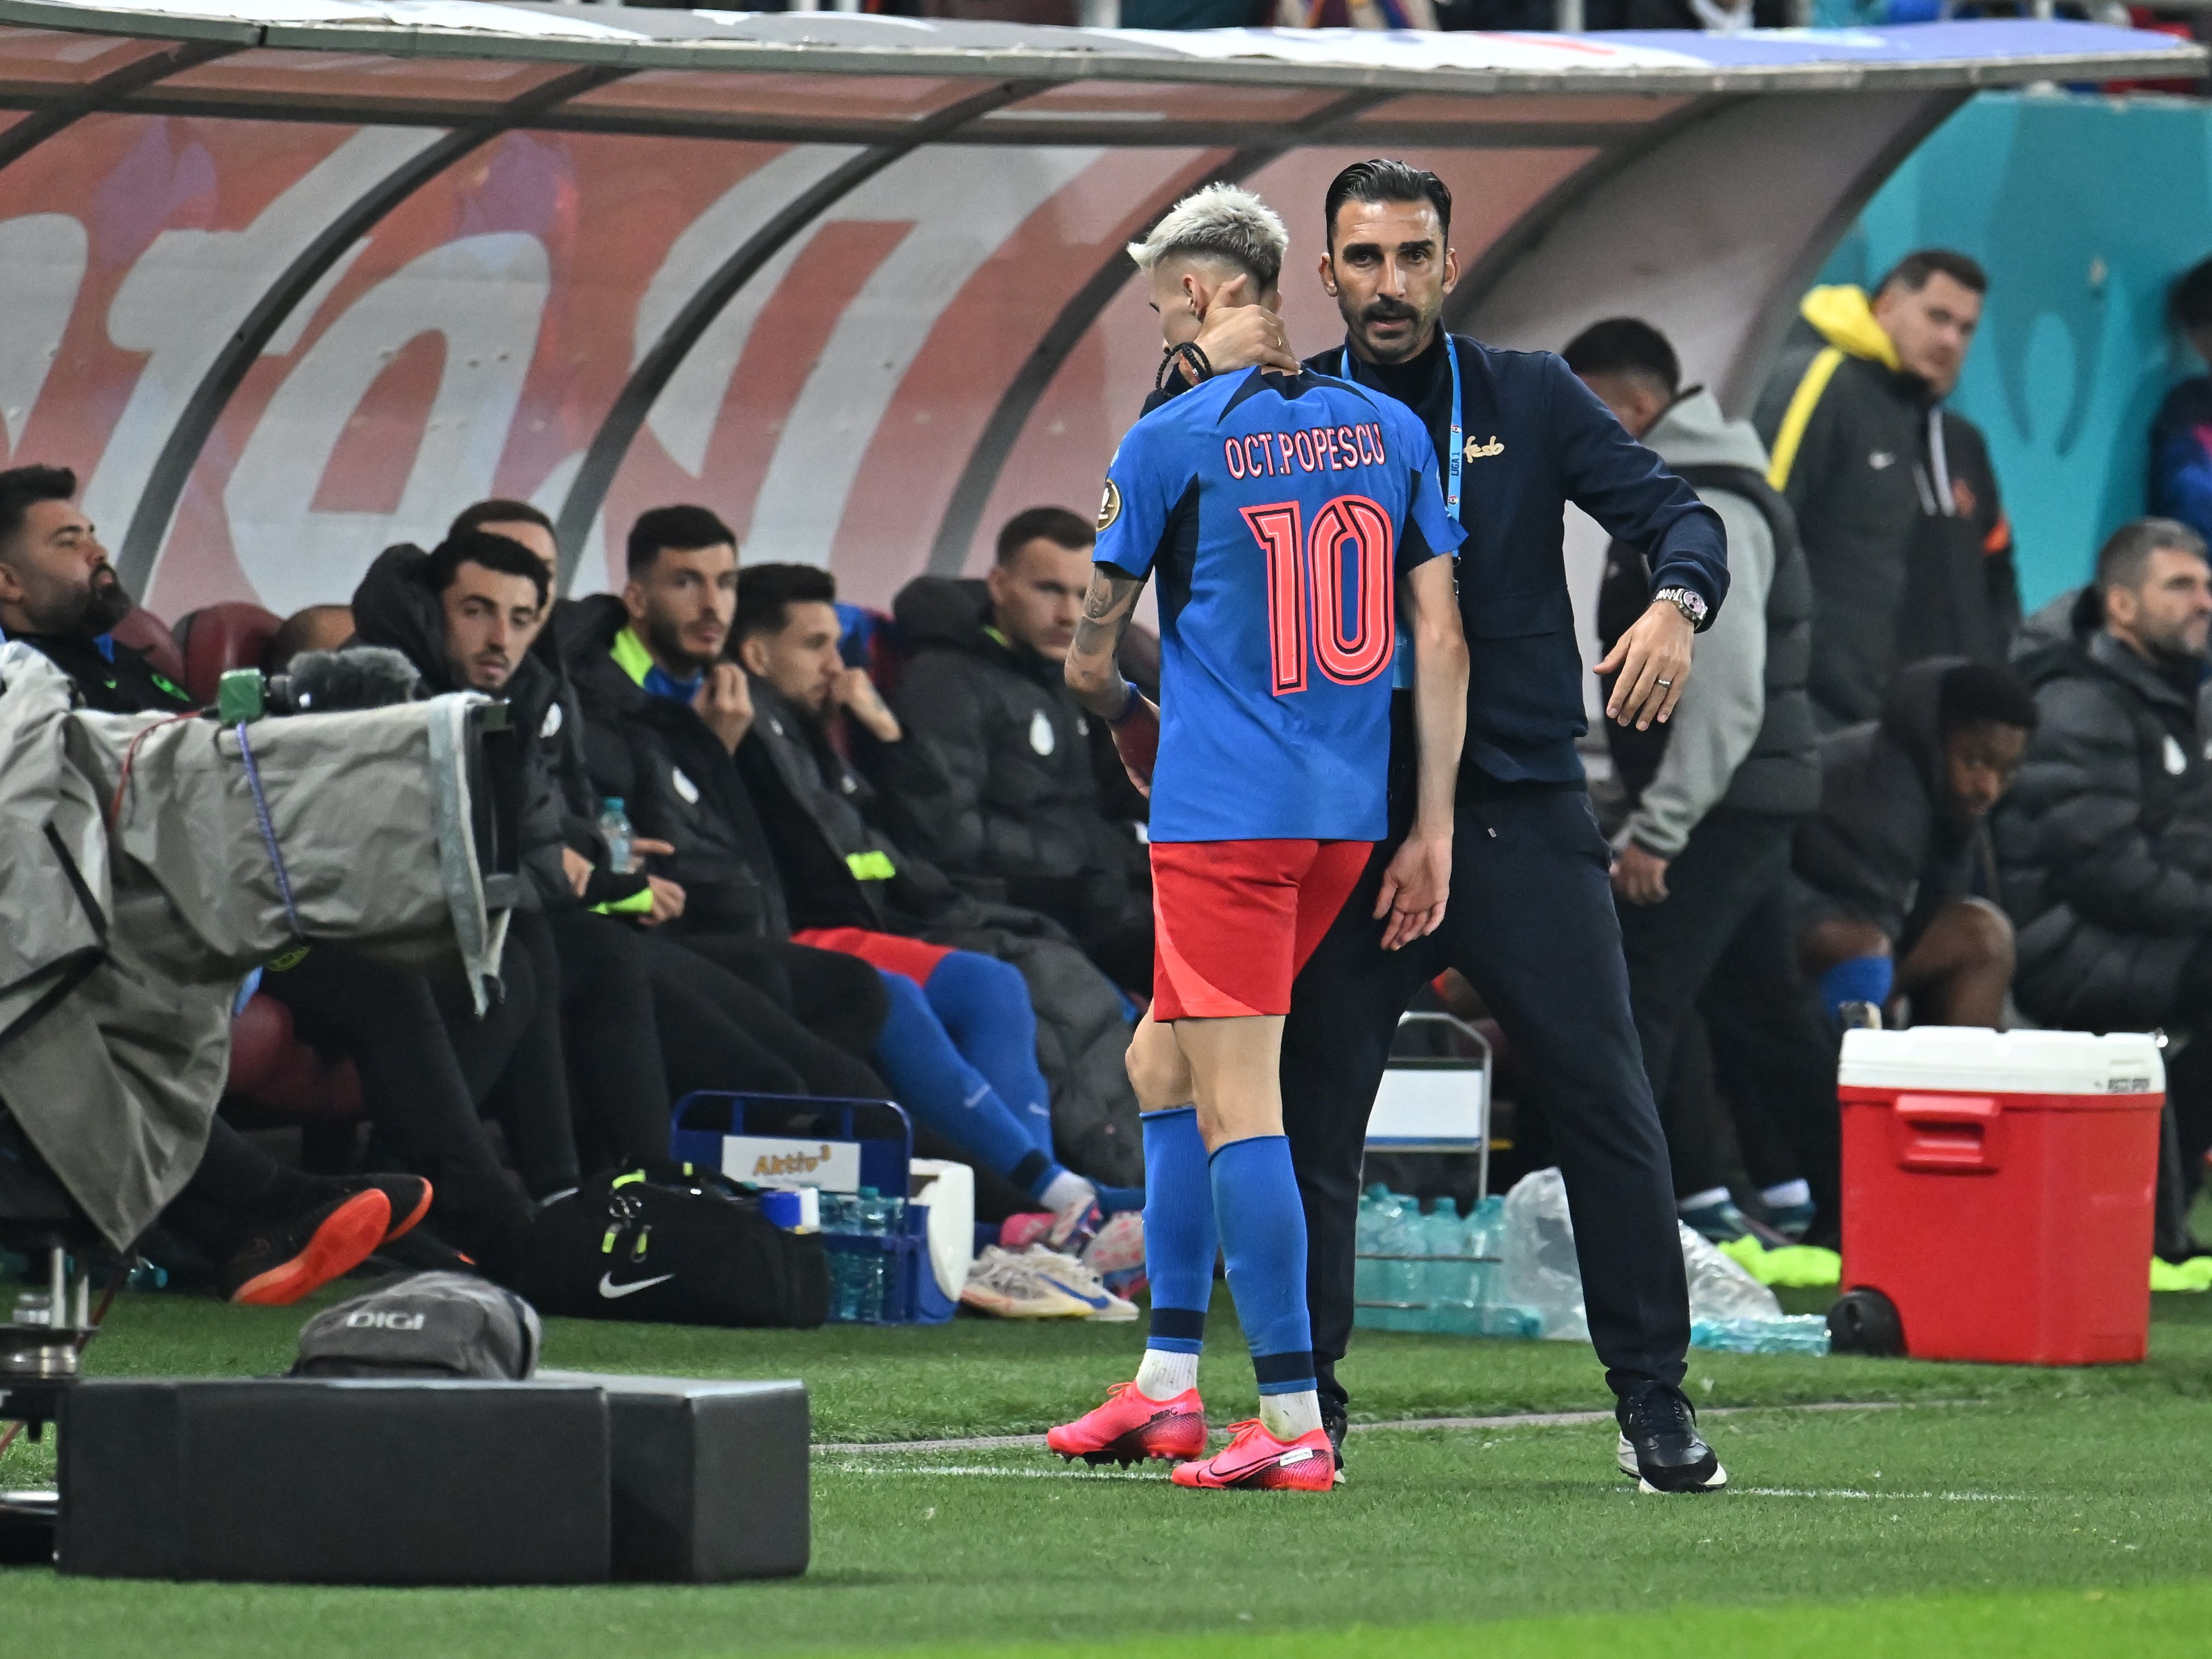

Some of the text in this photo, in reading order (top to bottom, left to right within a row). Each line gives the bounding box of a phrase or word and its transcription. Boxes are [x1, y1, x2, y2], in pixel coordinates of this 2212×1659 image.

[1224, 422, 1386, 479] OCT.POPESCU
[1450, 458, 1460, 477] LIGA
[1239, 495, 1395, 696] 10
[346, 1311, 425, 1331] DIGI
